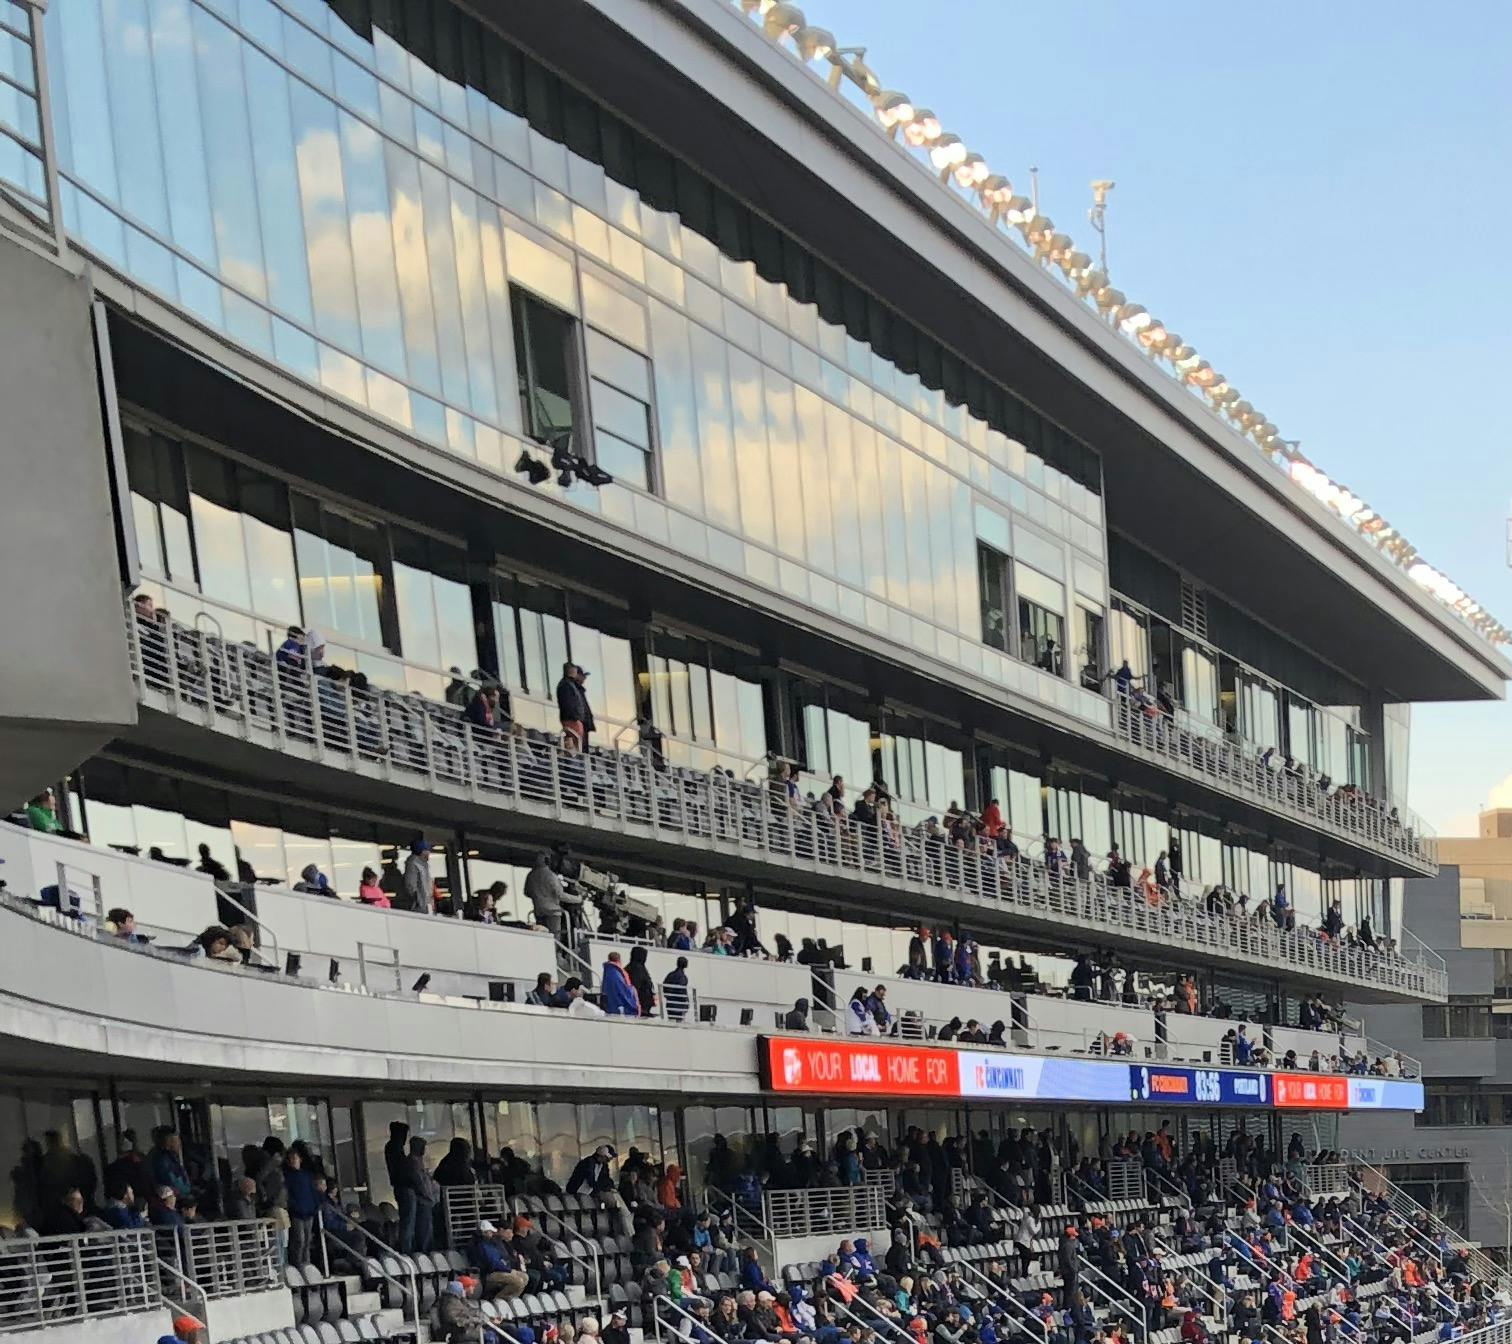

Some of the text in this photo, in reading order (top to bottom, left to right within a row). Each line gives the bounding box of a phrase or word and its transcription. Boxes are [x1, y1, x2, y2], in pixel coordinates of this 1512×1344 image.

[807, 1051, 948, 1085] YOUR LOCAL HOME FOR
[975, 1063, 1024, 1090] FC CINCINNATI
[1140, 1066, 1150, 1099] 3
[1418, 1148, 1470, 1160] CENTER
